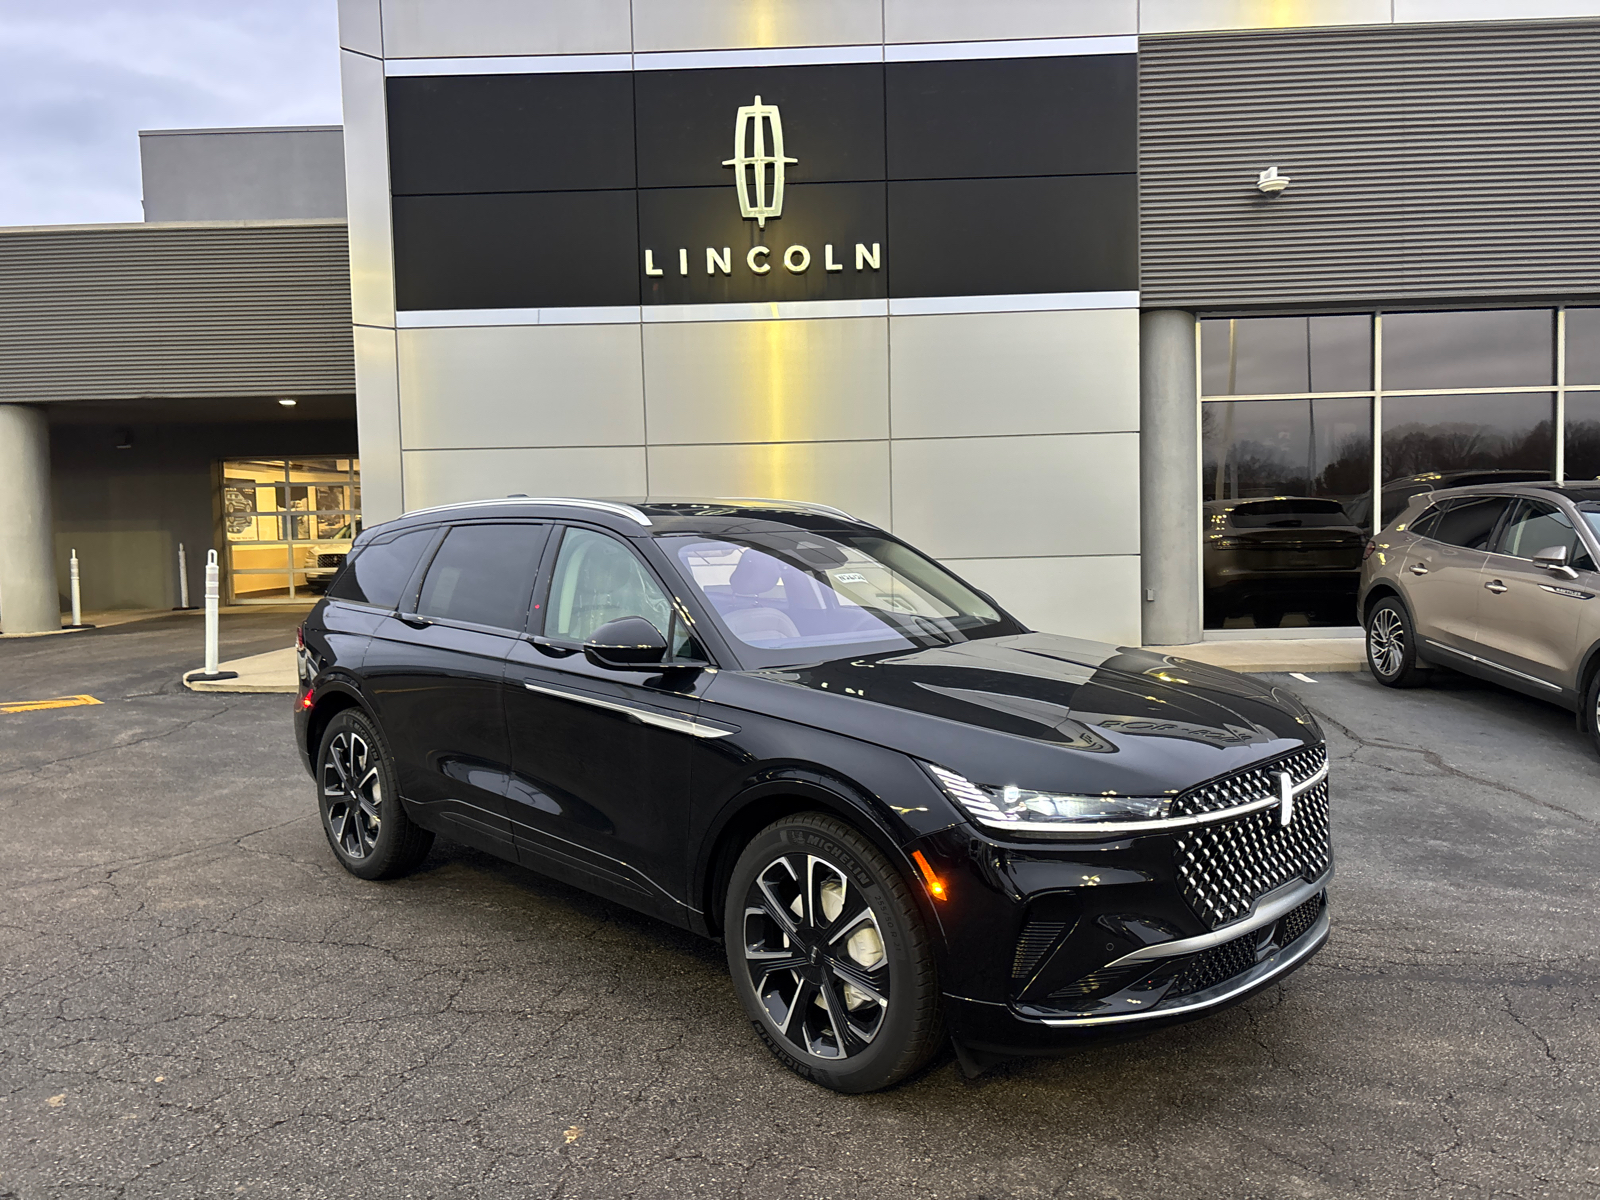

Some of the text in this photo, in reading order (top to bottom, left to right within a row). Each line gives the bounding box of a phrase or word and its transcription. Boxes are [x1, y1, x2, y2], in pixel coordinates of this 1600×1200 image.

[645, 243, 881, 276] LINCOLN
[354, 722, 379, 760] MICHELIN
[807, 834, 870, 886] MICHELIN
[874, 896, 894, 928] 255/50
[754, 1023, 810, 1077] MICHELIN
